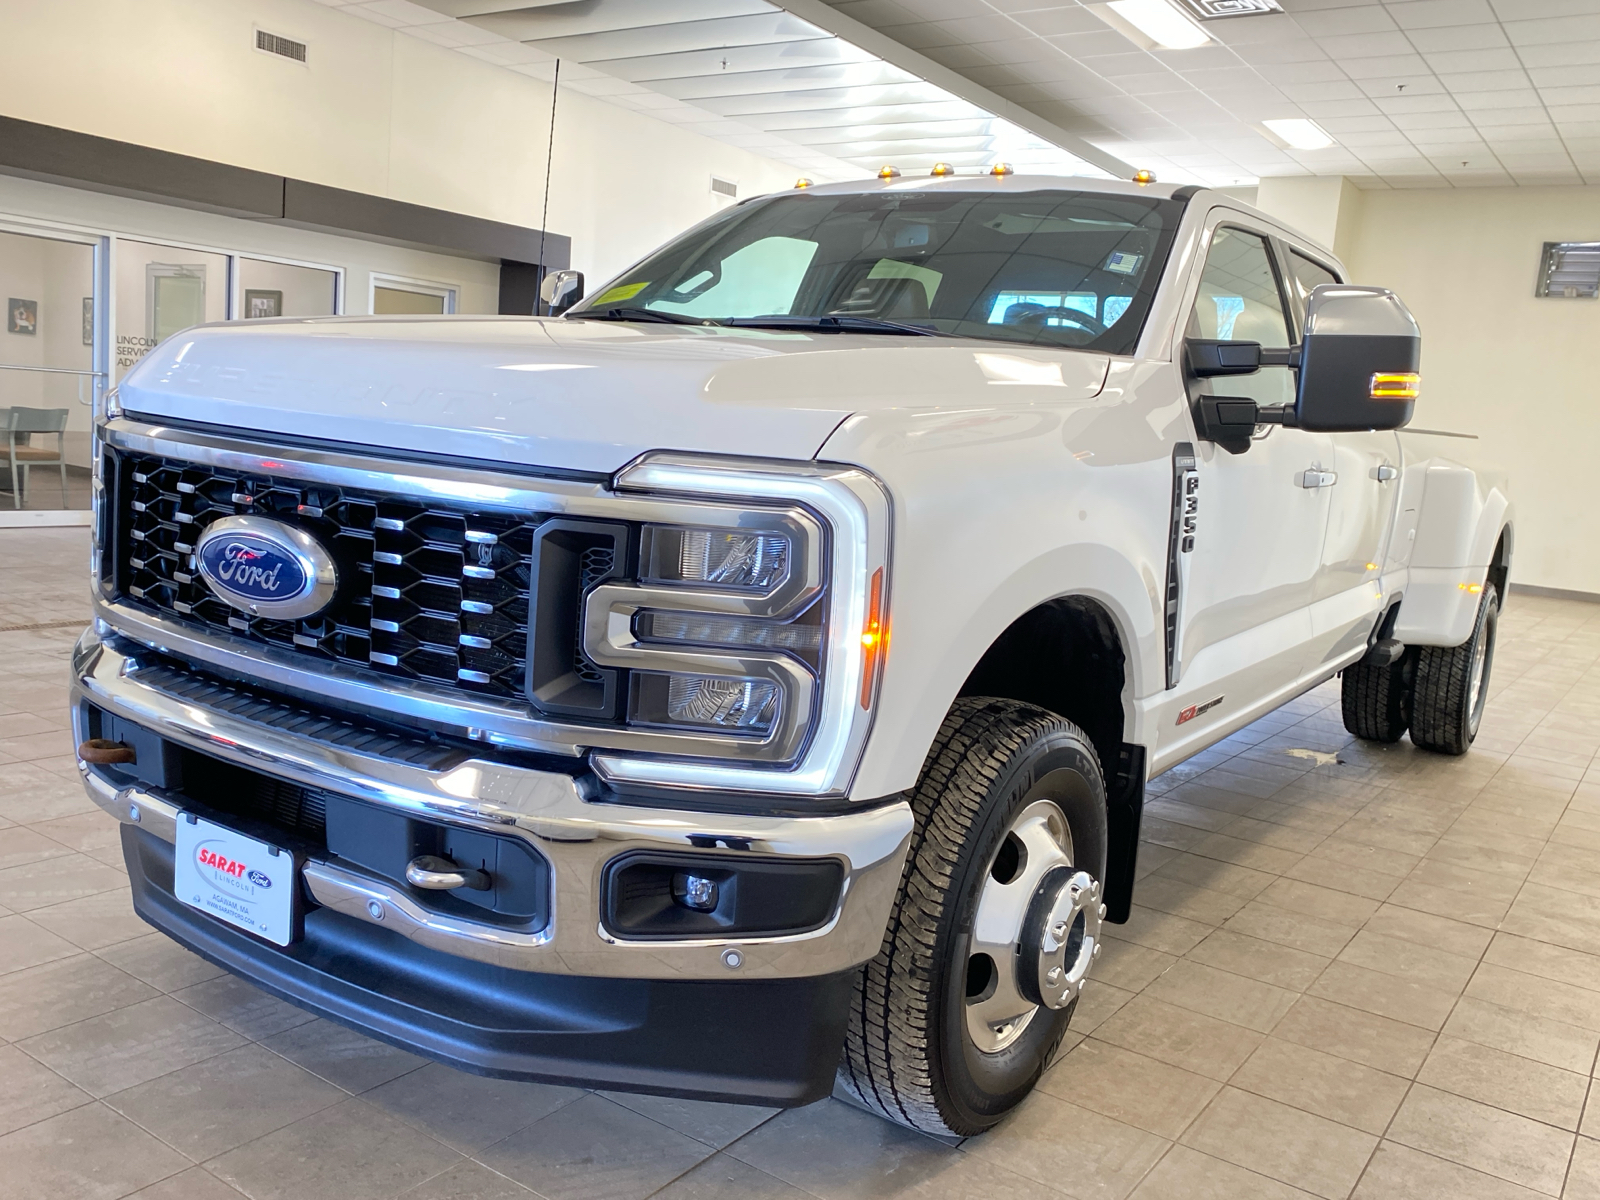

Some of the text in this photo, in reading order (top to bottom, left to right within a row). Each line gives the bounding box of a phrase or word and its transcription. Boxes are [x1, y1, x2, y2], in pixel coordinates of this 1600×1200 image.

[116, 335, 158, 347] LINCOLN
[116, 346, 149, 357] SERVIC
[218, 543, 283, 591] Ford
[199, 848, 246, 878] SARAT
[219, 874, 250, 892] LINCOLN
